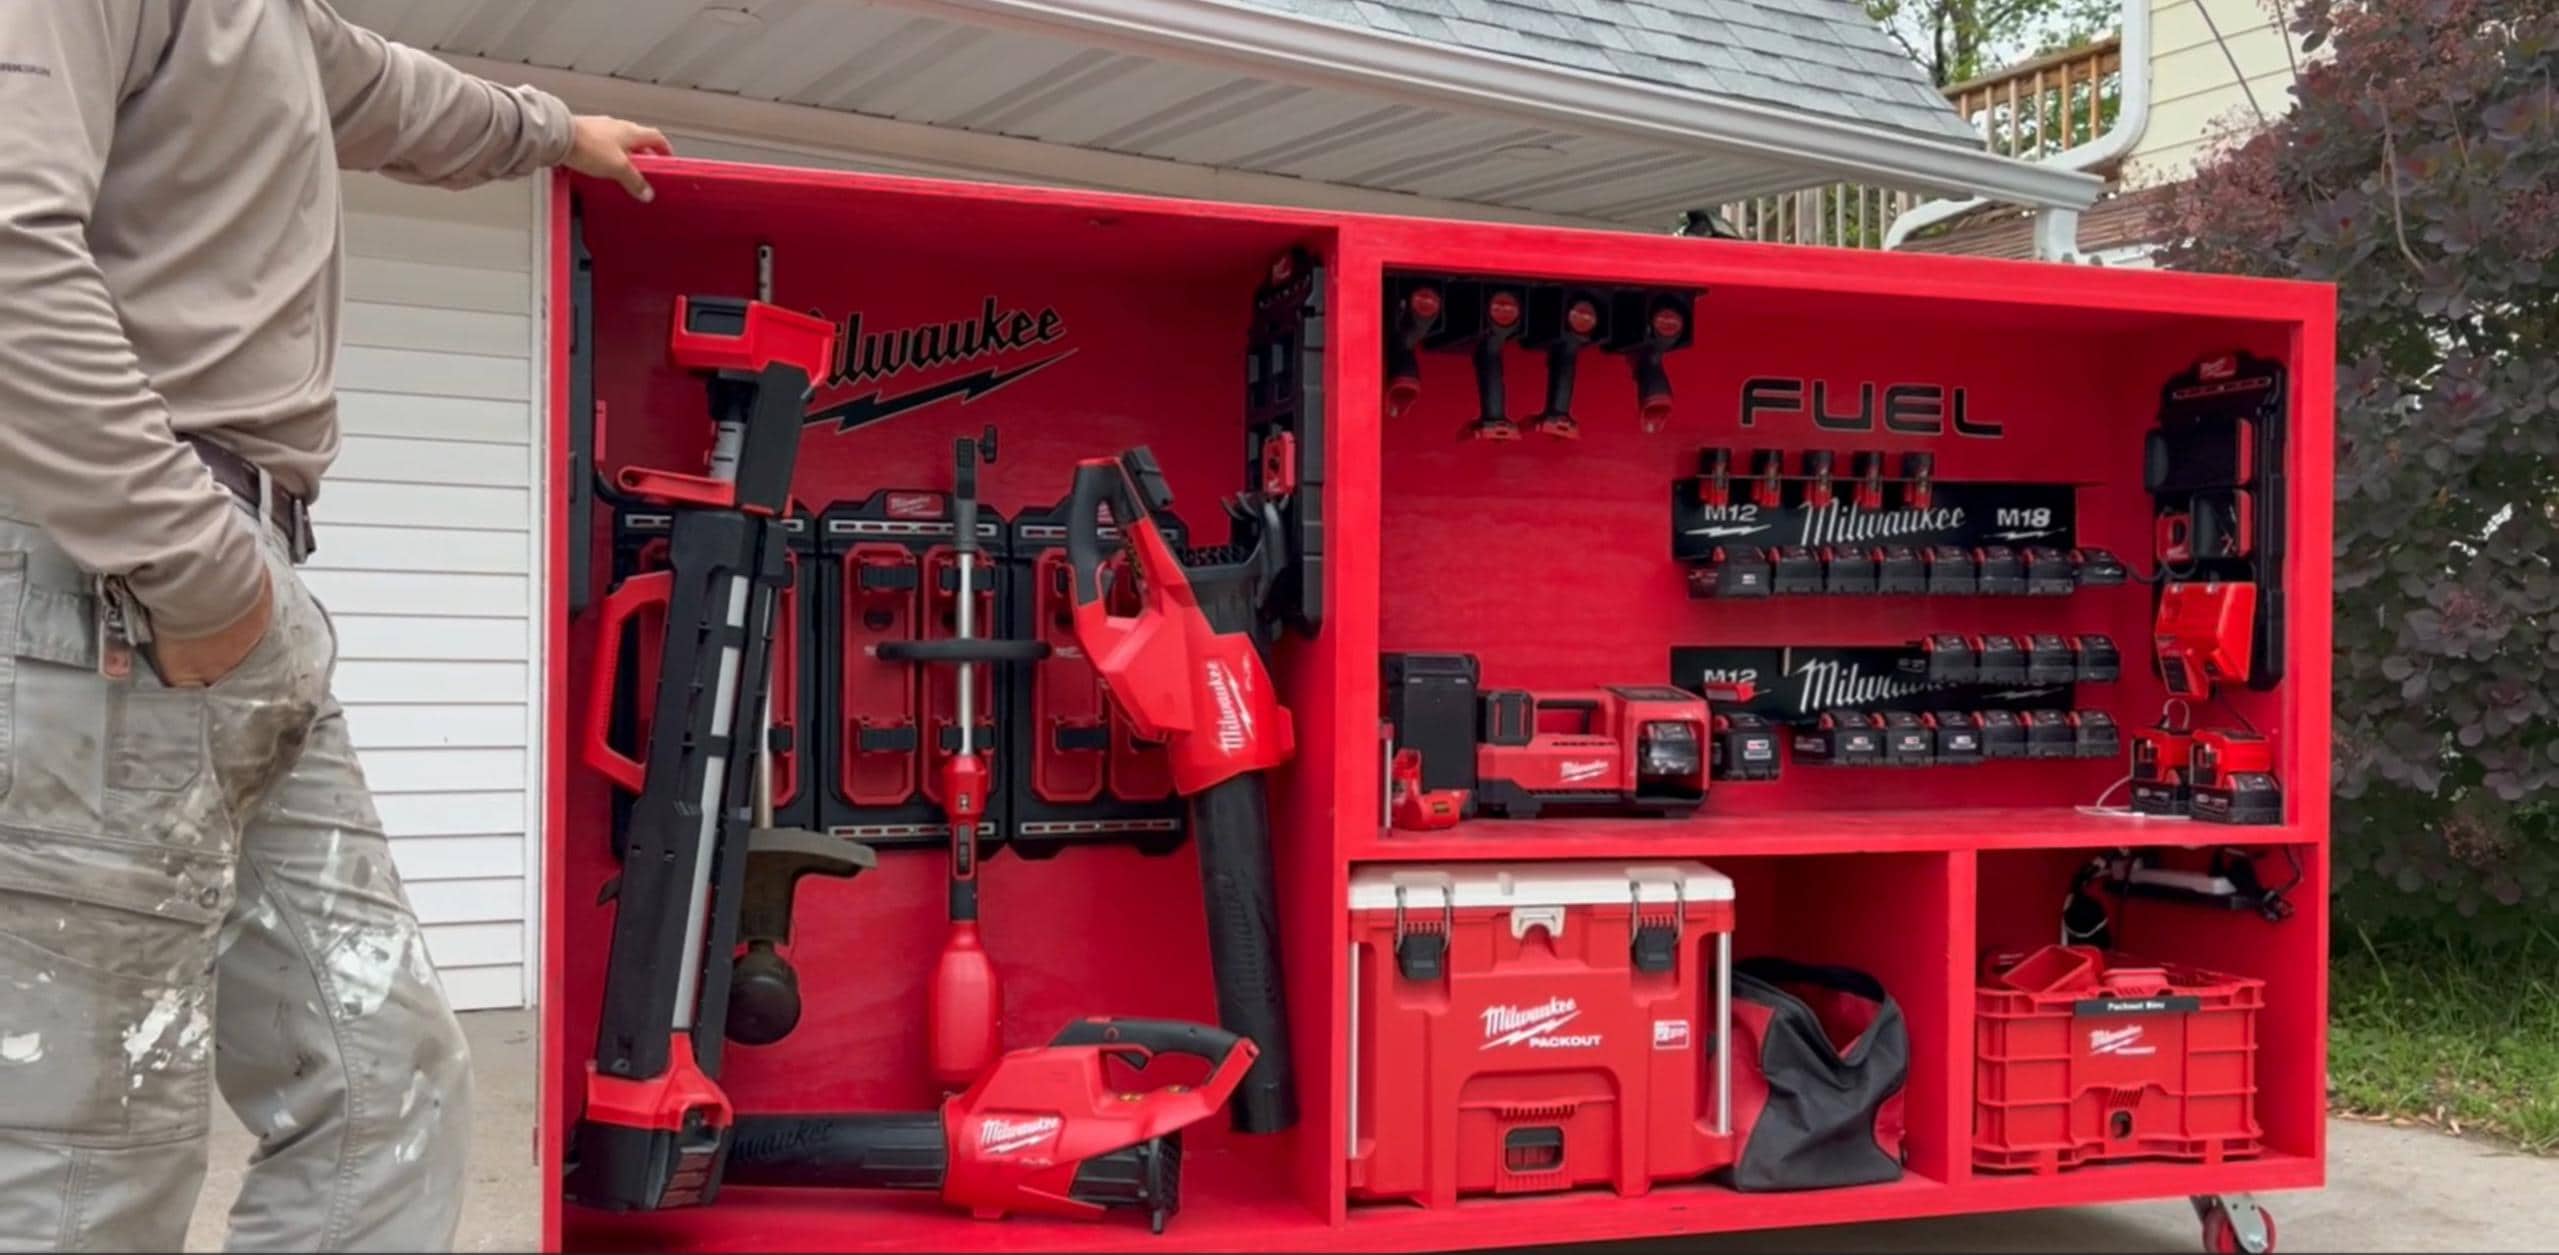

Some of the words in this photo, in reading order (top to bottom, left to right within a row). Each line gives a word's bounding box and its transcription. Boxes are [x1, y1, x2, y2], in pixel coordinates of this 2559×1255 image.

[807, 296, 1067, 390] ilwaukee
[1740, 377, 2004, 438] FUEL
[1704, 504, 1757, 522] M12
[1798, 498, 1966, 546] Milwaukee
[1996, 507, 2051, 527] M18
[1704, 668, 1758, 684] M12
[1479, 996, 1577, 1038] Milwaukee
[1529, 1034, 1602, 1048] PACKOUT
[982, 1116, 1060, 1145] Milwaukee
